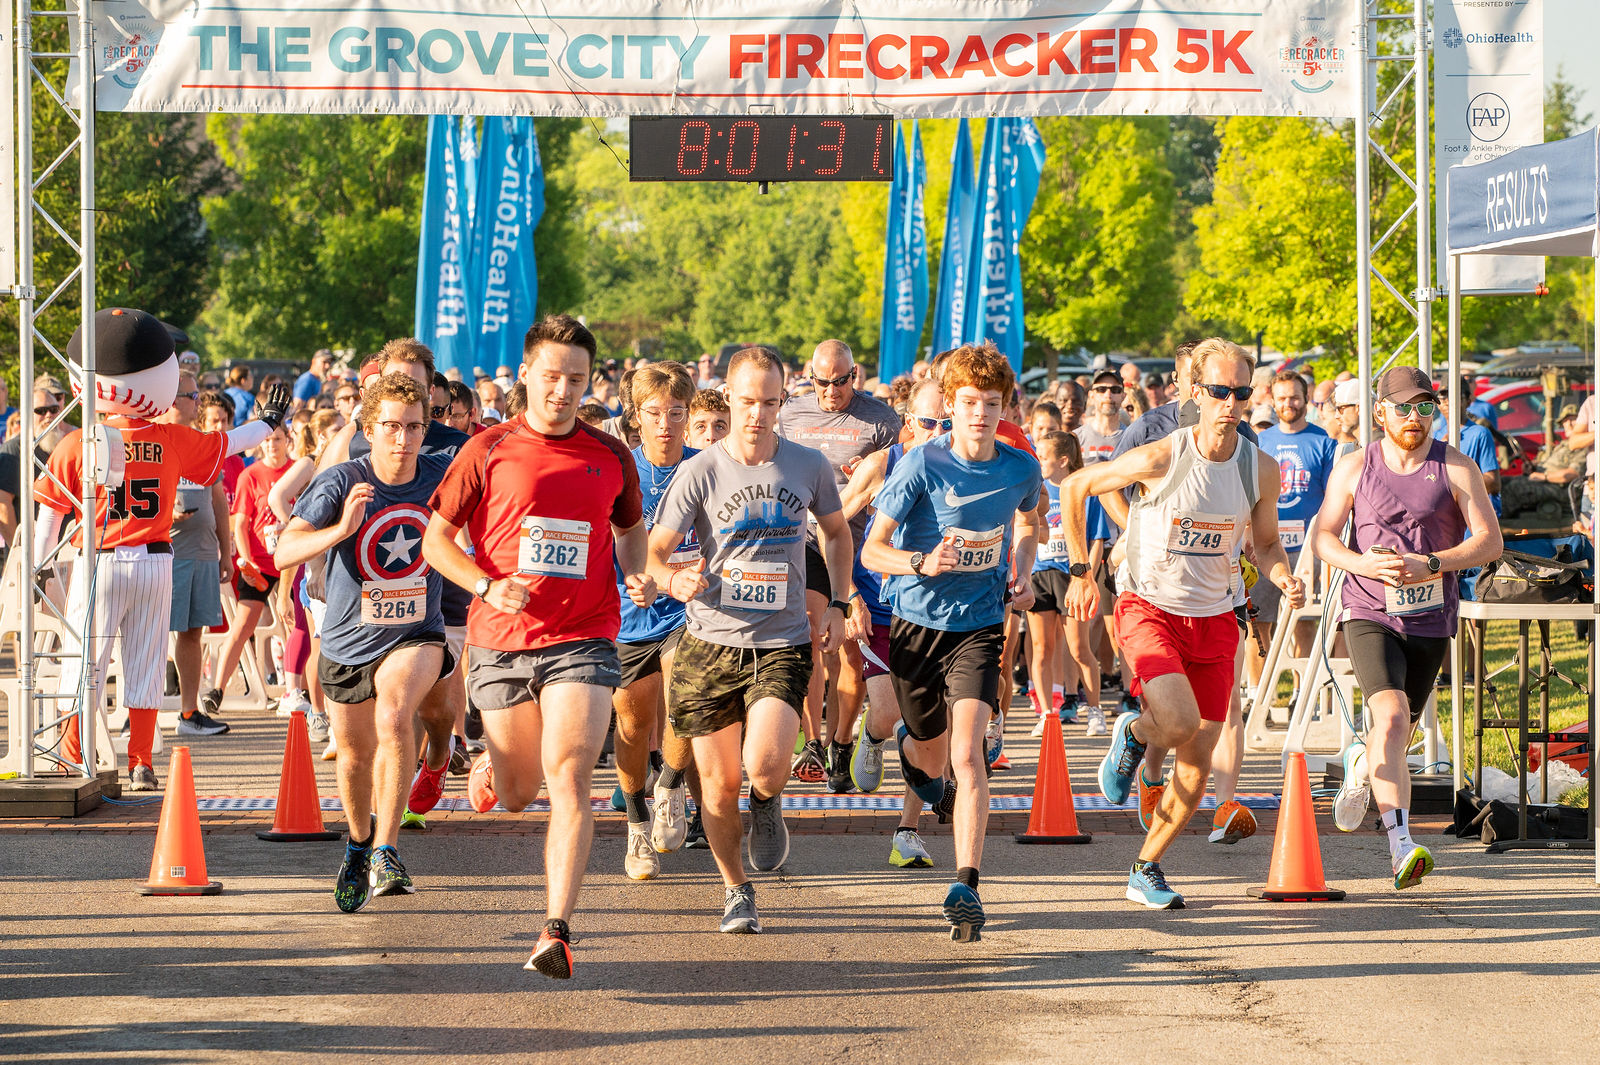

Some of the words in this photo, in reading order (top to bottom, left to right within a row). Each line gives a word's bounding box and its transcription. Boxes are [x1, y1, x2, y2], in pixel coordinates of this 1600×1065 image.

[1466, 32, 1534, 44] OhioHealth
[194, 25, 309, 72] THE
[328, 28, 550, 76] GROVE
[566, 33, 709, 79] CITY
[729, 29, 1158, 80] FIRECRACKER
[1173, 28, 1254, 75] 5K
[1472, 107, 1505, 127] FAP
[677, 121, 886, 175] 8:01:31
[1462, 145, 1469, 153] &
[1470, 144, 1493, 152] Ankle
[1486, 163, 1549, 234] RESULTS
[109, 478, 160, 520] 15
[717, 484, 774, 523] CAPITAL
[777, 487, 805, 514] CITY
[561, 533, 588, 541] PENGUIN
[1179, 530, 1222, 548] 3749
[530, 543, 578, 566] 3262
[399, 588, 426, 596] PENGUIN
[731, 584, 777, 604] 3286
[1395, 584, 1435, 606] 3827
[372, 600, 417, 619] 3264
